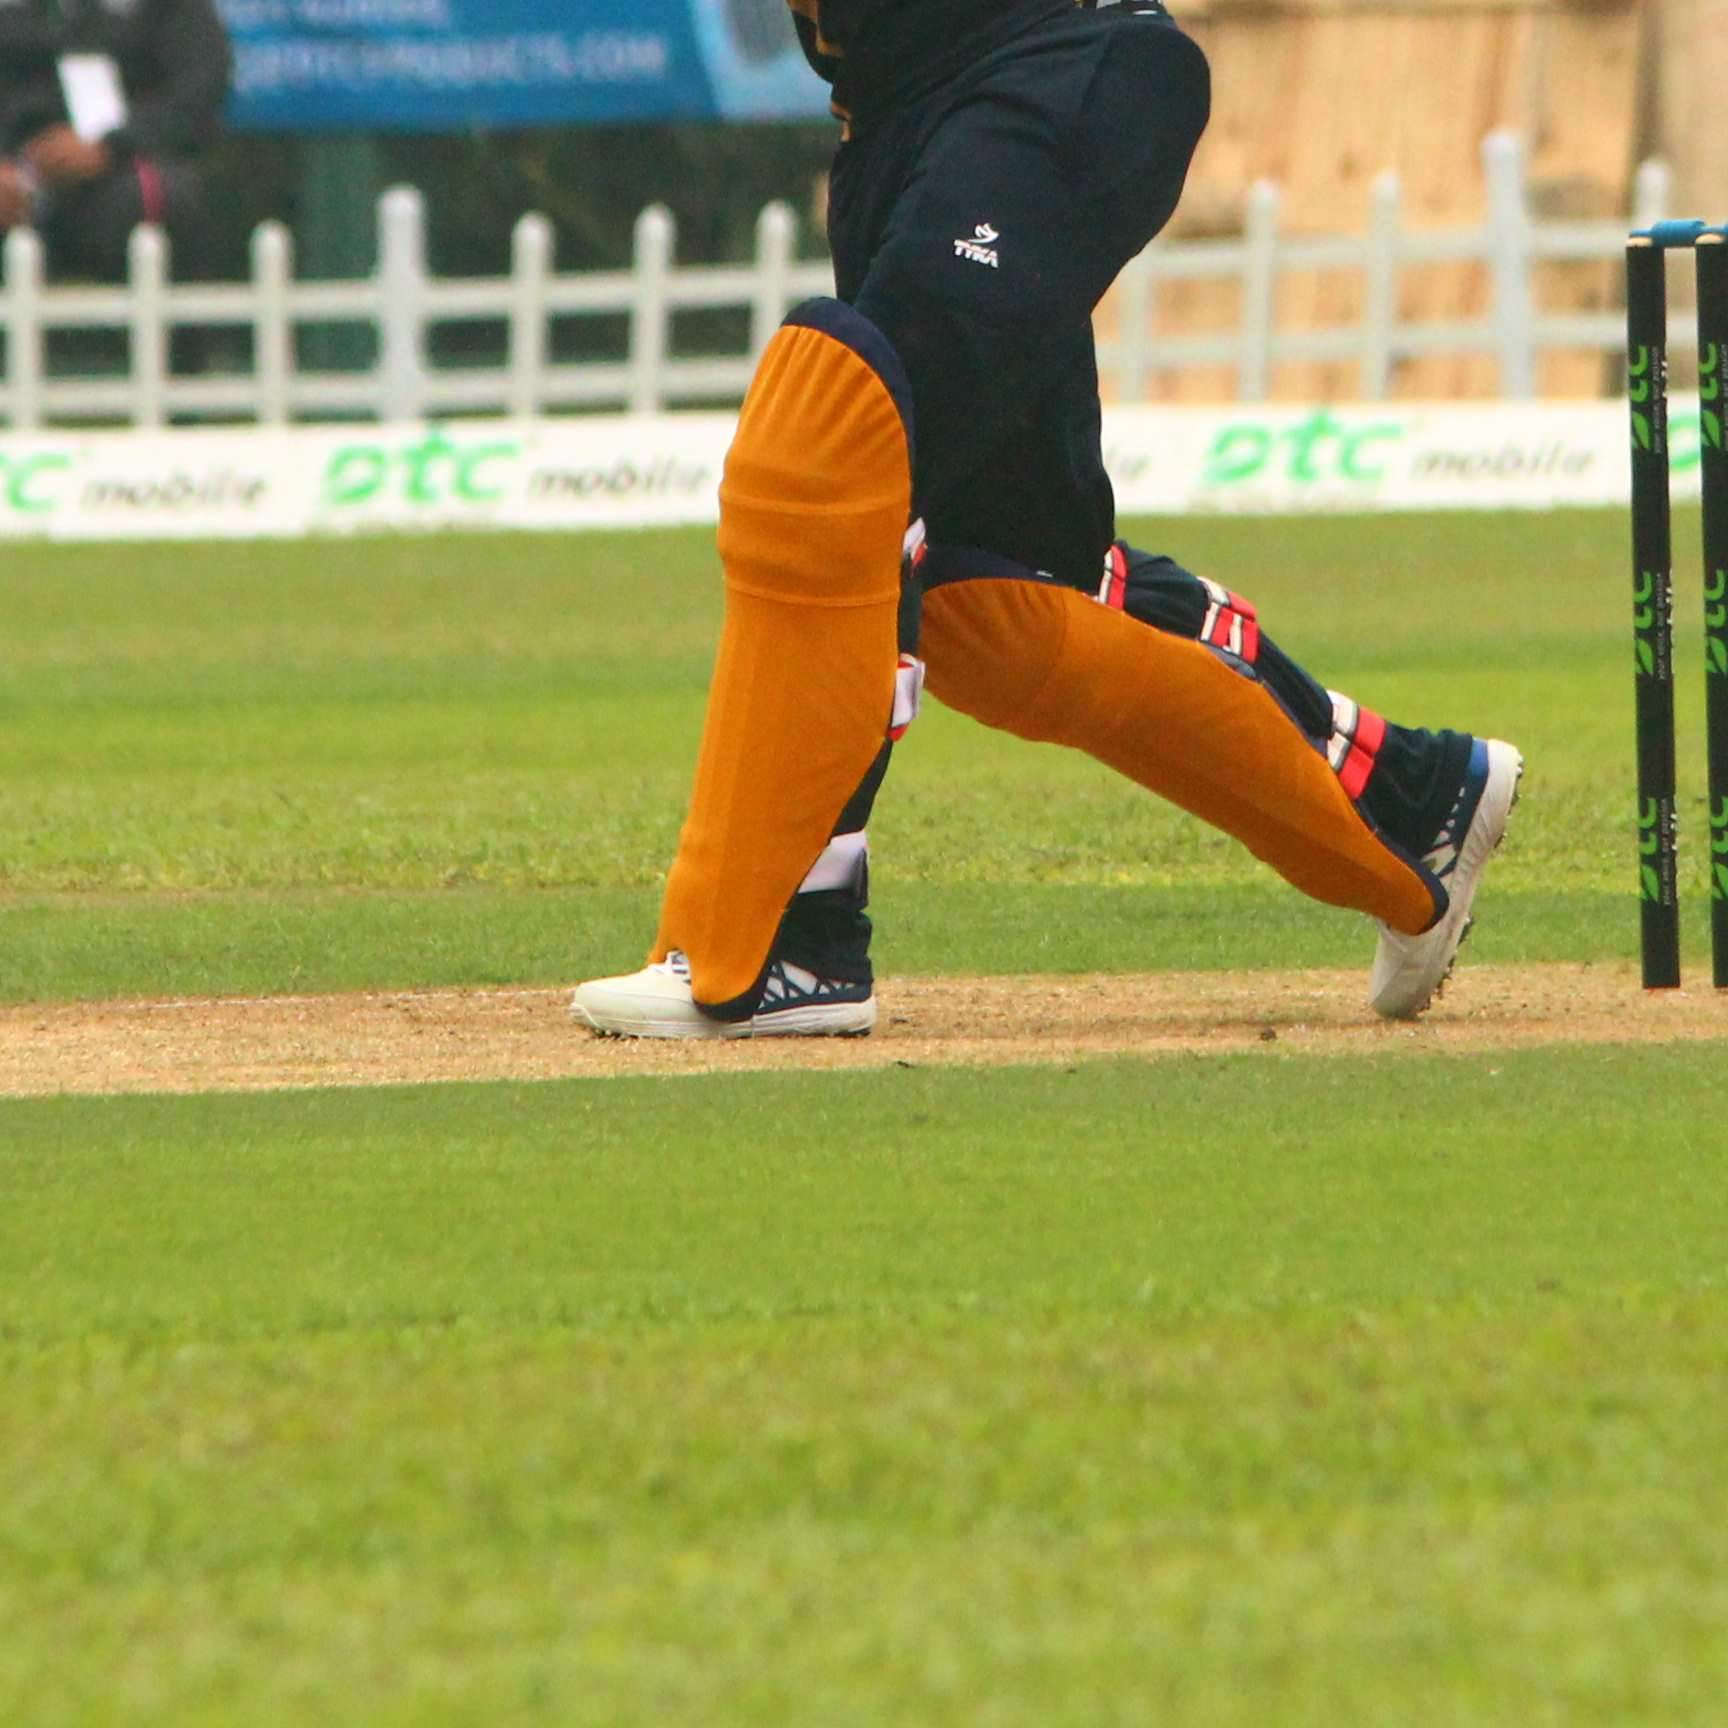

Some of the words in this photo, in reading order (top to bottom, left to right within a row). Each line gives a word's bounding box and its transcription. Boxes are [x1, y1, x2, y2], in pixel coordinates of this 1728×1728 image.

[1412, 440, 1597, 479] mobile
[83, 466, 266, 510] mobile
[528, 460, 712, 500] mobile
